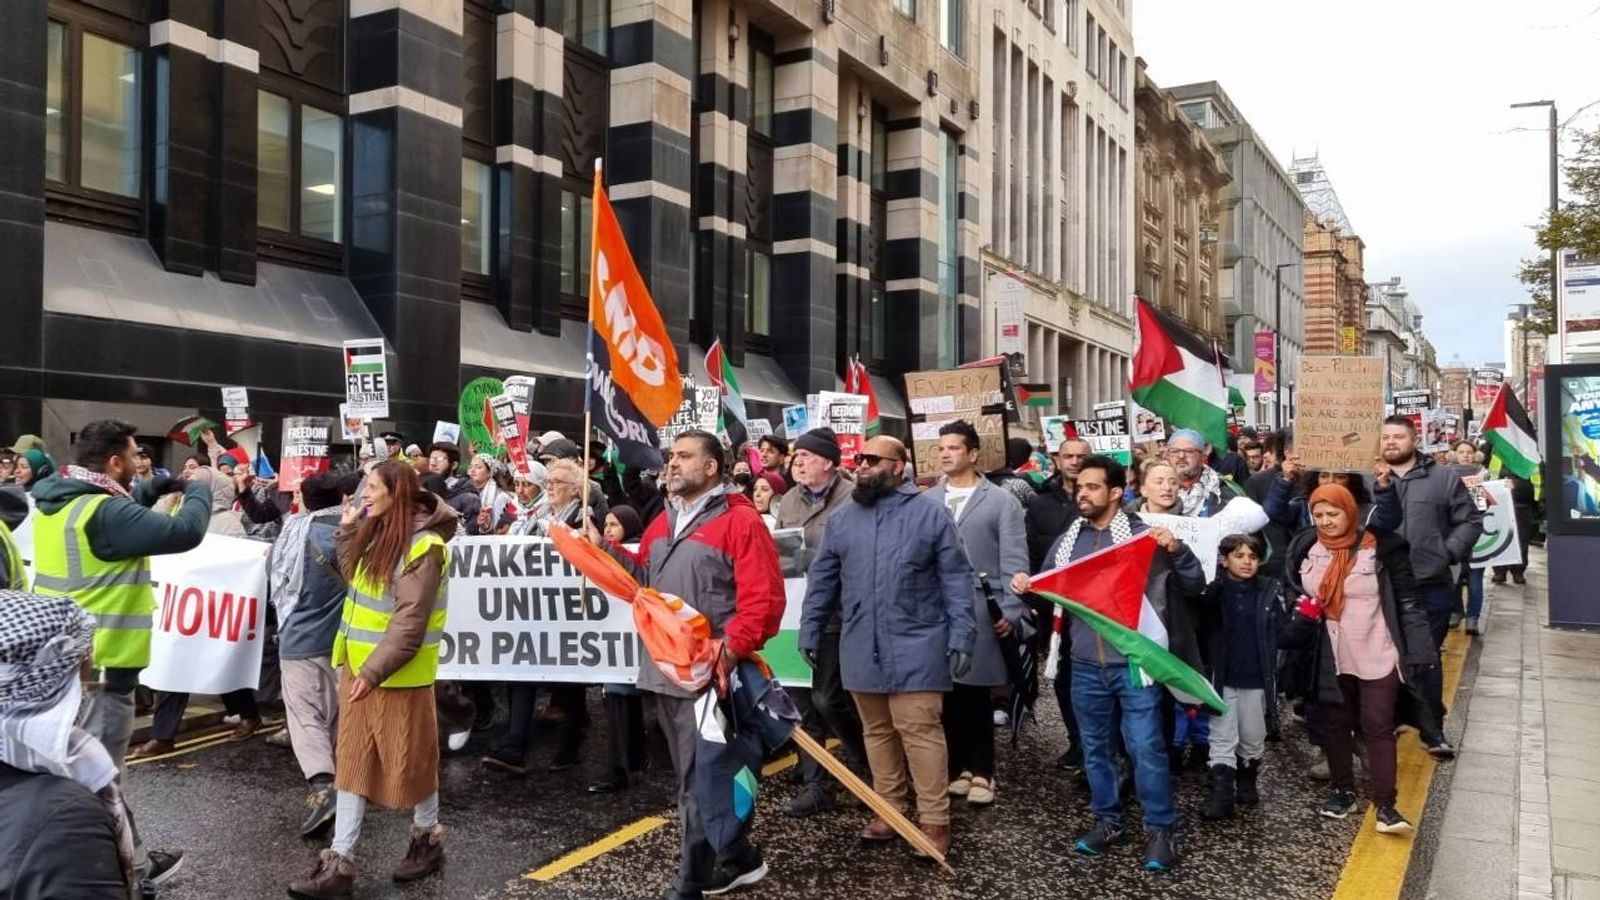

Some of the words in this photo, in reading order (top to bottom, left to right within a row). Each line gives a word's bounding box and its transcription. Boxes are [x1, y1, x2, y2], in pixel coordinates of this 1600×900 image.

[347, 373, 385, 393] FREE
[913, 373, 988, 396] EVERY
[287, 427, 328, 439] FREEDOM
[284, 444, 329, 458] PALESTINE
[449, 543, 583, 578] WAKEFI
[159, 583, 258, 642] NOW!
[478, 587, 610, 621] UNITED
[439, 631, 480, 665] OR
[491, 631, 643, 667] PALESTI
